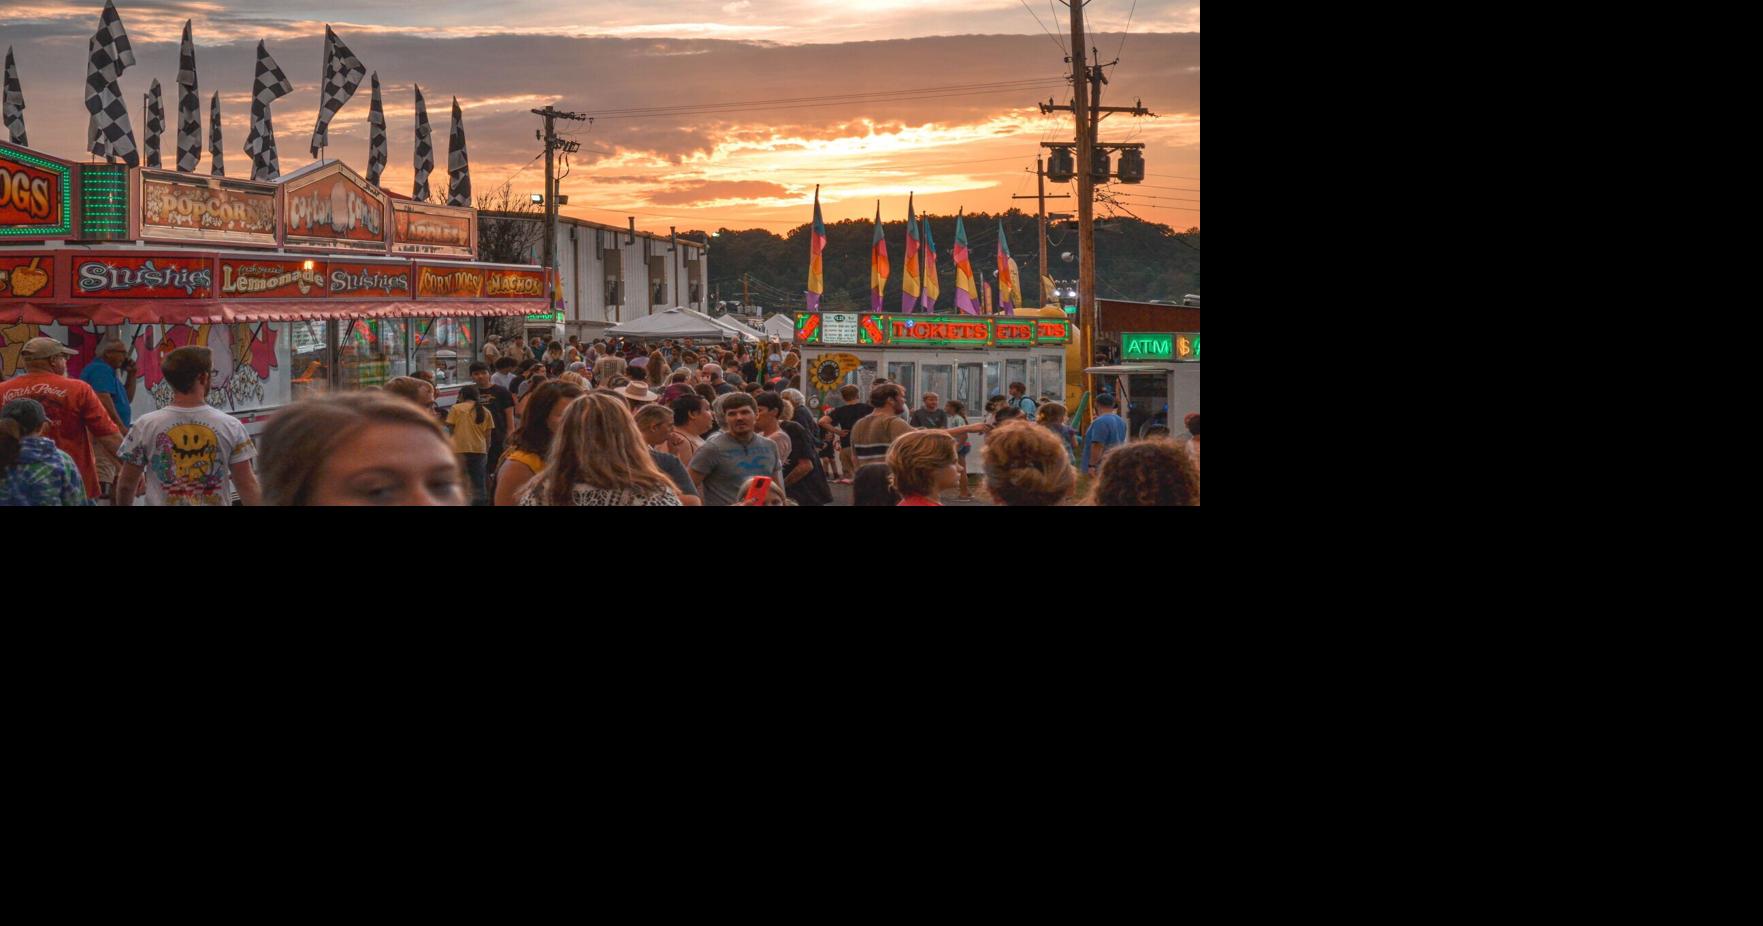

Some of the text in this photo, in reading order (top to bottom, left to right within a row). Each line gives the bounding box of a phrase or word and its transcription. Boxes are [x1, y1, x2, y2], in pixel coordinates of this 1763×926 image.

[222, 265, 324, 293] Lemonade
[424, 271, 479, 292] CORN DOGS
[492, 272, 542, 294] NACHOS
[893, 321, 988, 339] TICKETS
[1128, 340, 1168, 354] ATM
[32, 383, 66, 397] Point
